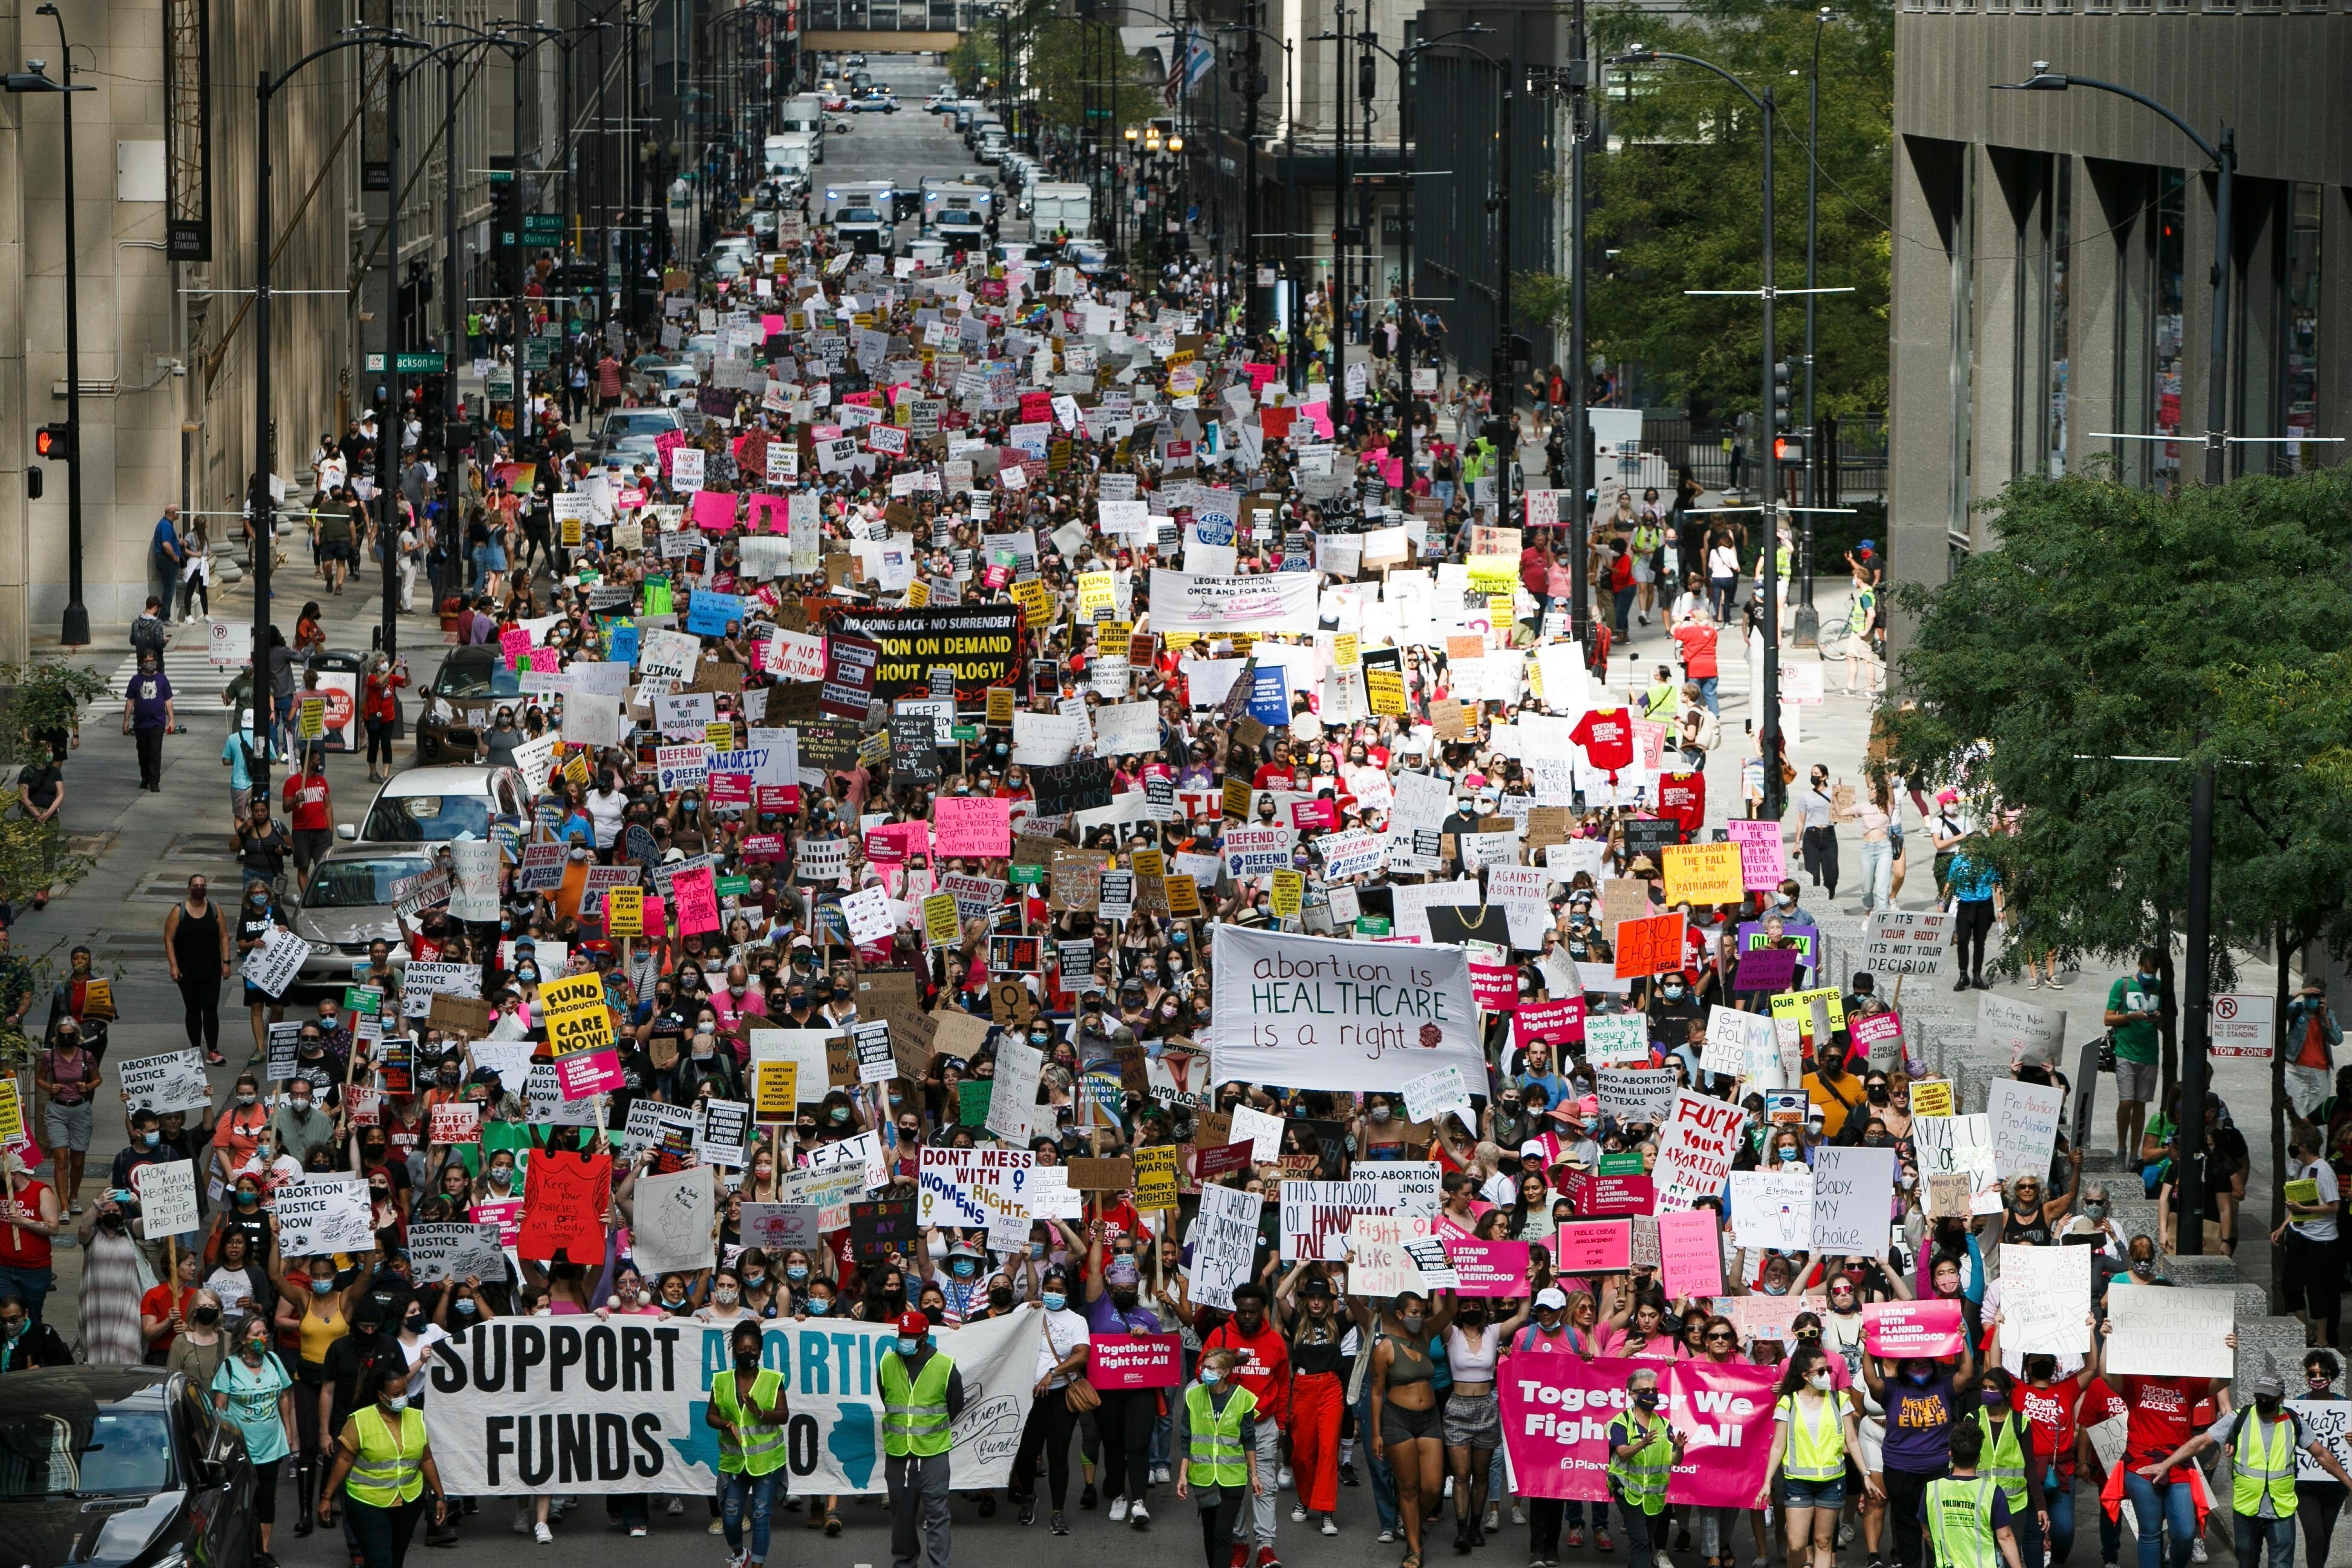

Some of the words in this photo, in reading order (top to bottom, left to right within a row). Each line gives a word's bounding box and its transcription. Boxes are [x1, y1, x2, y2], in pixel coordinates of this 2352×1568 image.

[175, 232, 198, 241] CENTRAL
[524, 234, 550, 244] Quincy
[174, 241, 200, 250] STANDARD
[397, 357, 428, 368] ackson
[849, 407, 875, 416] UPHOLD
[873, 426, 904, 442] PUSSY
[832, 440, 854, 452] NEVER
[878, 438, 904, 451] POWER
[678, 454, 701, 463] ABORT
[675, 478, 702, 486] PATRIARCHY
[1101, 504, 1119, 512] Mind
[1319, 497, 1351, 514] WOC
[1206, 514, 1229, 523] KEEP
[1198, 521, 1233, 535] ABORTION
[1201, 532, 1228, 544] LEGAL
[1194, 577, 1222, 585] LEGAL
[1224, 577, 1272, 585] ABORTION
[843, 618, 859, 630] NO
[862, 618, 892, 630] GOING
[895, 618, 923, 630] BACK
[930, 617, 946, 628] NO
[834, 642, 875, 658] Women's
[915, 639, 936, 655] ON
[944, 636, 1011, 654] DEMAND
[833, 650, 863, 664] Bodies
[647, 663, 682, 678] UTERUS
[839, 663, 856, 673] Are
[838, 671, 863, 685] More
[825, 682, 869, 700] Regulated
[669, 700, 681, 708] WE
[683, 699, 700, 708] ARE
[822, 689, 846, 704] Than
[846, 695, 869, 709] Guns
[678, 709, 691, 719] NOT
[659, 747, 701, 760] DEFEND
[708, 748, 769, 771] MAJORITY
[660, 760, 684, 768] WOMEN'S
[950, 798, 998, 810] TEXAS:
[938, 812, 964, 820] WHERE
[936, 820, 952, 829] HAS
[955, 819, 1010, 828] REPRODUCTIVE
[938, 828, 970, 838] RIGHTS
[973, 828, 989, 837] AND
[942, 841, 975, 851] WOMAN
[1663, 846, 1677, 855] MY
[1679, 845, 1692, 854] FAV
[1694, 843, 1726, 854] SEASON
[1731, 843, 1740, 851] IS
[1683, 856, 1702, 866] THE
[1705, 855, 1726, 865] FALL
[1676, 880, 1730, 892] PATRIARCHY
[1878, 913, 1887, 923] IF
[1893, 913, 1913, 924] IT'S
[1924, 915, 1944, 926] NOT
[1635, 919, 1670, 939] PRO
[1881, 928, 1905, 939] YOUR
[1914, 930, 1940, 941] BODY
[1619, 941, 1679, 964] CHOICE
[1869, 942, 1886, 954] IT'S
[1892, 944, 1912, 955] NOT
[1917, 946, 1941, 956] YOUR
[1253, 951, 1391, 980] abortion
[1411, 959, 1432, 986] is
[1867, 958, 1937, 974] DECISION
[545, 984, 598, 1008] FUND
[1253, 982, 1448, 1021] HEALTHCARE
[544, 998, 606, 1016] REPRODUCTIVE
[555, 1016, 603, 1036] CARE
[557, 1030, 609, 1054] NOW!
[1253, 1022, 1278, 1047] is
[1298, 1025, 1318, 1045] a
[1340, 1022, 1408, 1060] right
[2215, 1047, 2236, 1056] TOW
[2241, 1048, 2269, 1057] ZONE
[121, 1053, 178, 1071] ABORTION
[124, 1068, 166, 1084] JUSTICE
[1598, 1074, 1676, 1085] PRO-ABORTION
[126, 1083, 155, 1096] NOW
[1598, 1084, 1625, 1095] FROM
[1628, 1085, 1671, 1096] ILLINOIS
[1598, 1094, 1610, 1103] TO
[1613, 1096, 1646, 1106] TEXAS
[1679, 1098, 1743, 1151] FUCK
[1684, 1129, 1725, 1156] YOUR
[923, 1149, 972, 1167] DONT
[982, 1152, 1031, 1169] MESS
[1665, 1146, 1730, 1179] ABORTION
[1818, 1152, 1841, 1169] MY
[142, 1163, 168, 1180] HOW
[956, 1168, 999, 1186] WITH
[161, 1172, 192, 1187] MANY
[1815, 1172, 1852, 1197] BODY.
[142, 1182, 195, 1200] ABORTIONS
[920, 1172, 984, 1224] WOMENS
[163, 1195, 184, 1204] HAS
[149, 1203, 190, 1217] TRUMP
[1814, 1200, 1840, 1221] MY
[149, 1216, 173, 1229] PAID
[176, 1210, 198, 1225] FOR?
[1812, 1225, 1863, 1246] Choice.
[1880, 1325, 1924, 1334] PLANNED
[1880, 1334, 1945, 1344] PARENTHOOD
[1097, 1344, 1149, 1356] Together
[1152, 1344, 1171, 1353] We
[431, 1324, 679, 1394] SUPPORT
[1100, 1356, 1129, 1368] Fight
[1132, 1356, 1149, 1365] for
[1151, 1355, 1168, 1365] All
[486, 1413, 664, 1487] FUNDS
[1942, 1500, 1975, 1510] VOLUNTEER
